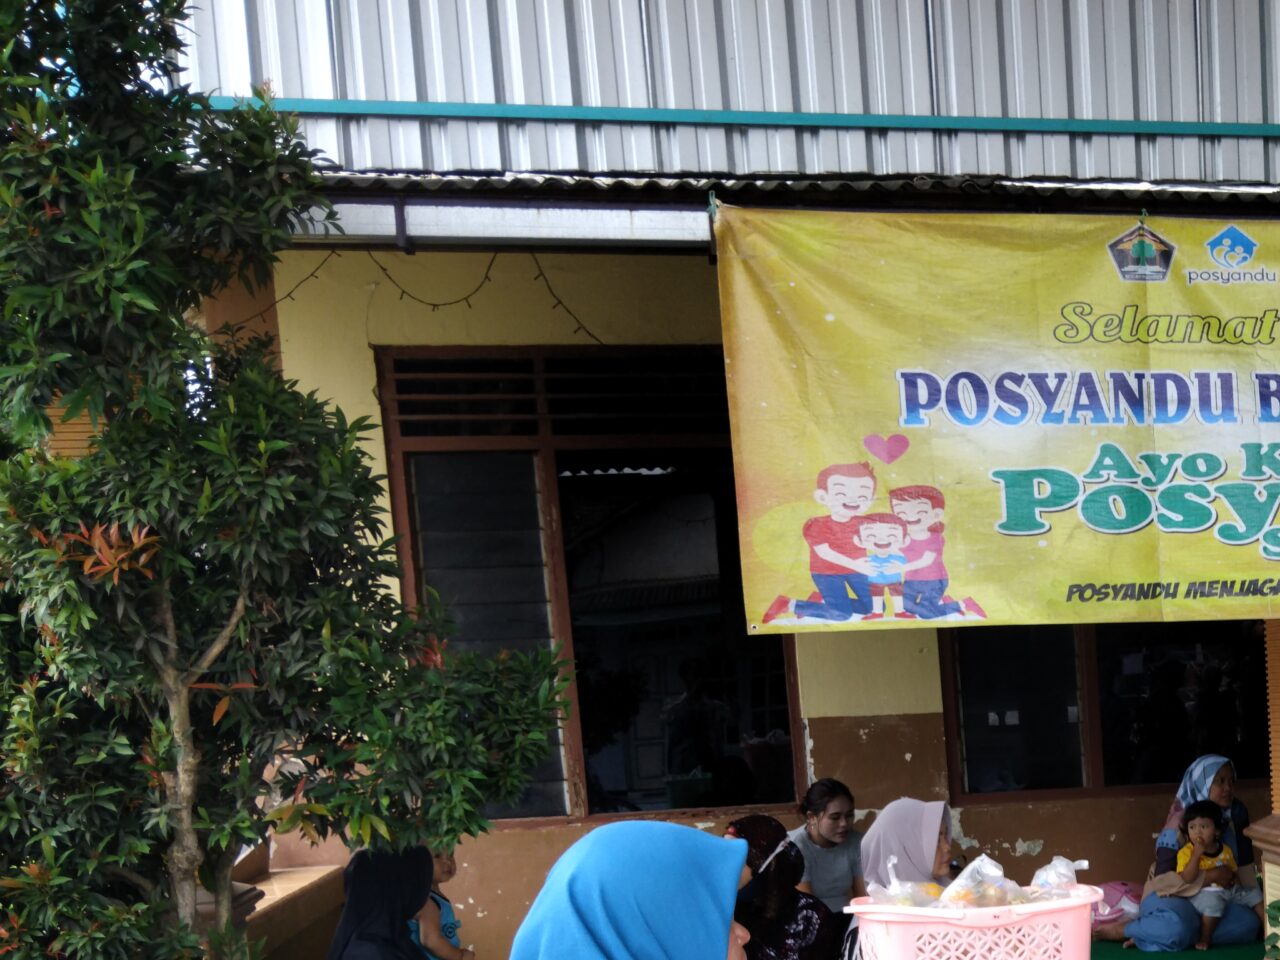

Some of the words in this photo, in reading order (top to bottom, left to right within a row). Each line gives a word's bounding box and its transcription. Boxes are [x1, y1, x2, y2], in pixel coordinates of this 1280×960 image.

[1187, 267, 1277, 284] posyandu
[1053, 301, 1280, 345] Selamat
[899, 370, 1234, 426] POSYANDU
[1084, 442, 1225, 489] Ayo
[1066, 582, 1181, 603] POSYANDU
